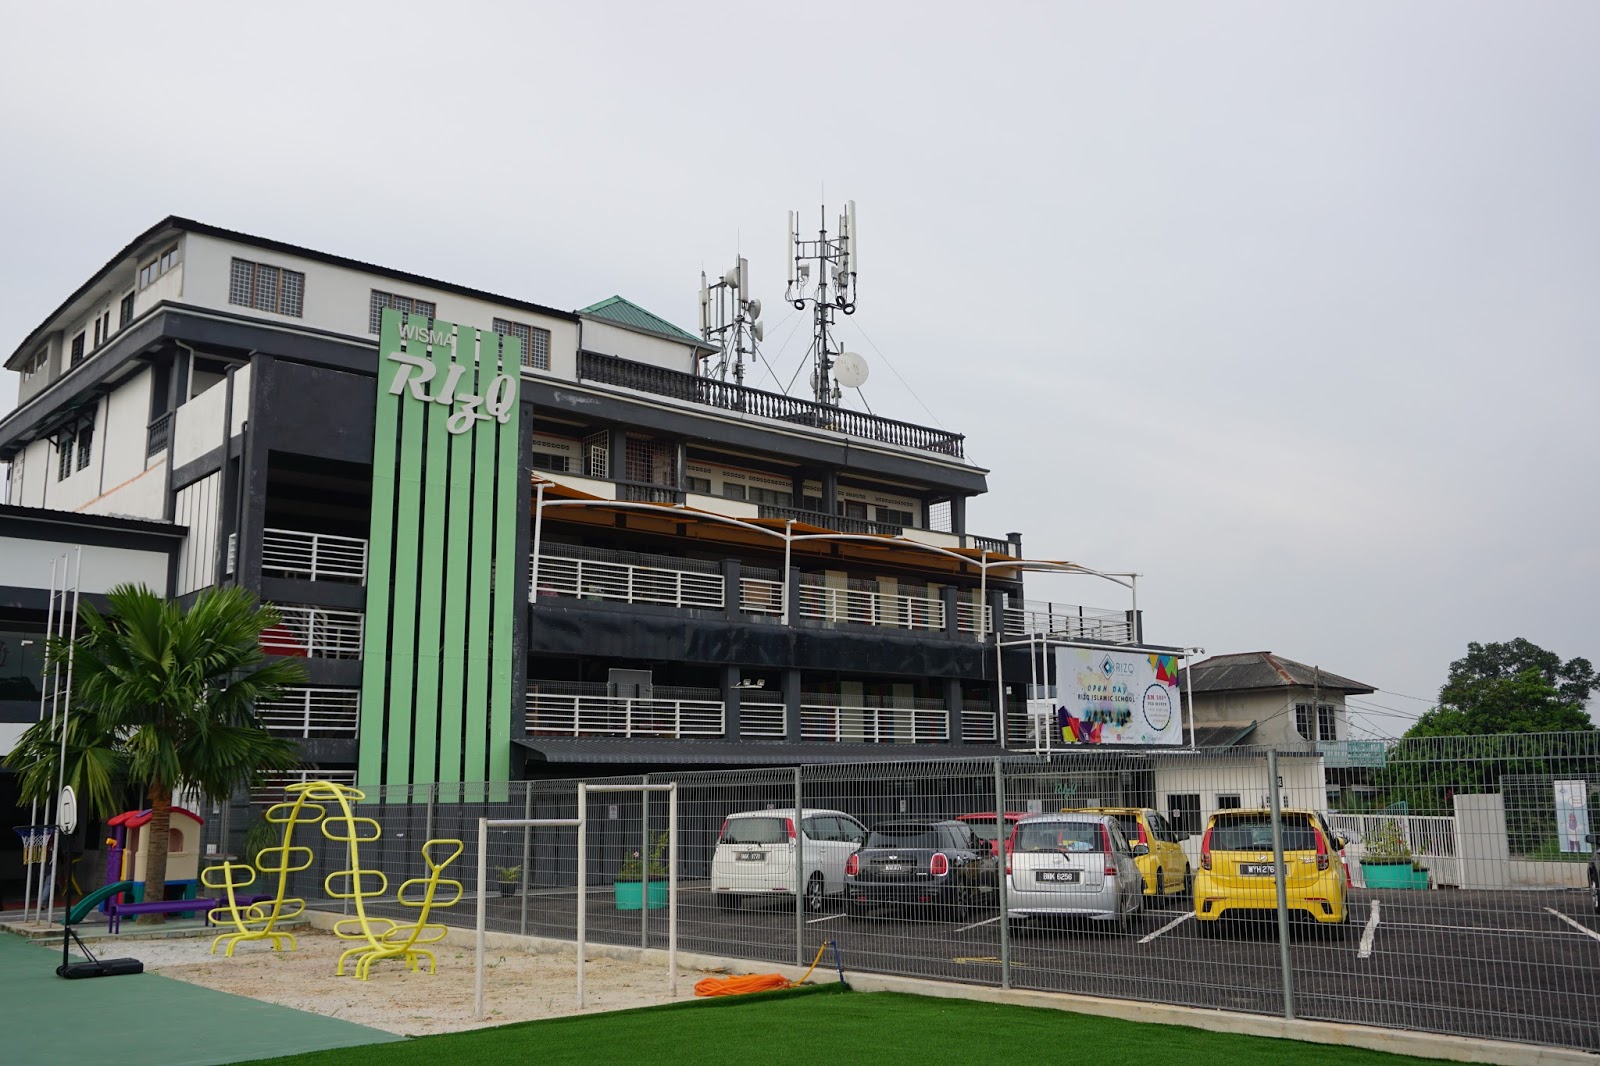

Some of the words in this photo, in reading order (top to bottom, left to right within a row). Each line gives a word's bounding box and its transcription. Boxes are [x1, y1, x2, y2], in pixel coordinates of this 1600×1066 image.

[398, 322, 454, 347] WISMA
[1115, 662, 1135, 675] RIZQ
[1087, 684, 1107, 692] OPEN
[1112, 685, 1128, 694] DAY
[1091, 694, 1113, 702] ISLAMIC
[1114, 695, 1136, 703] SCHOOL
[1248, 865, 1262, 873] WYH
